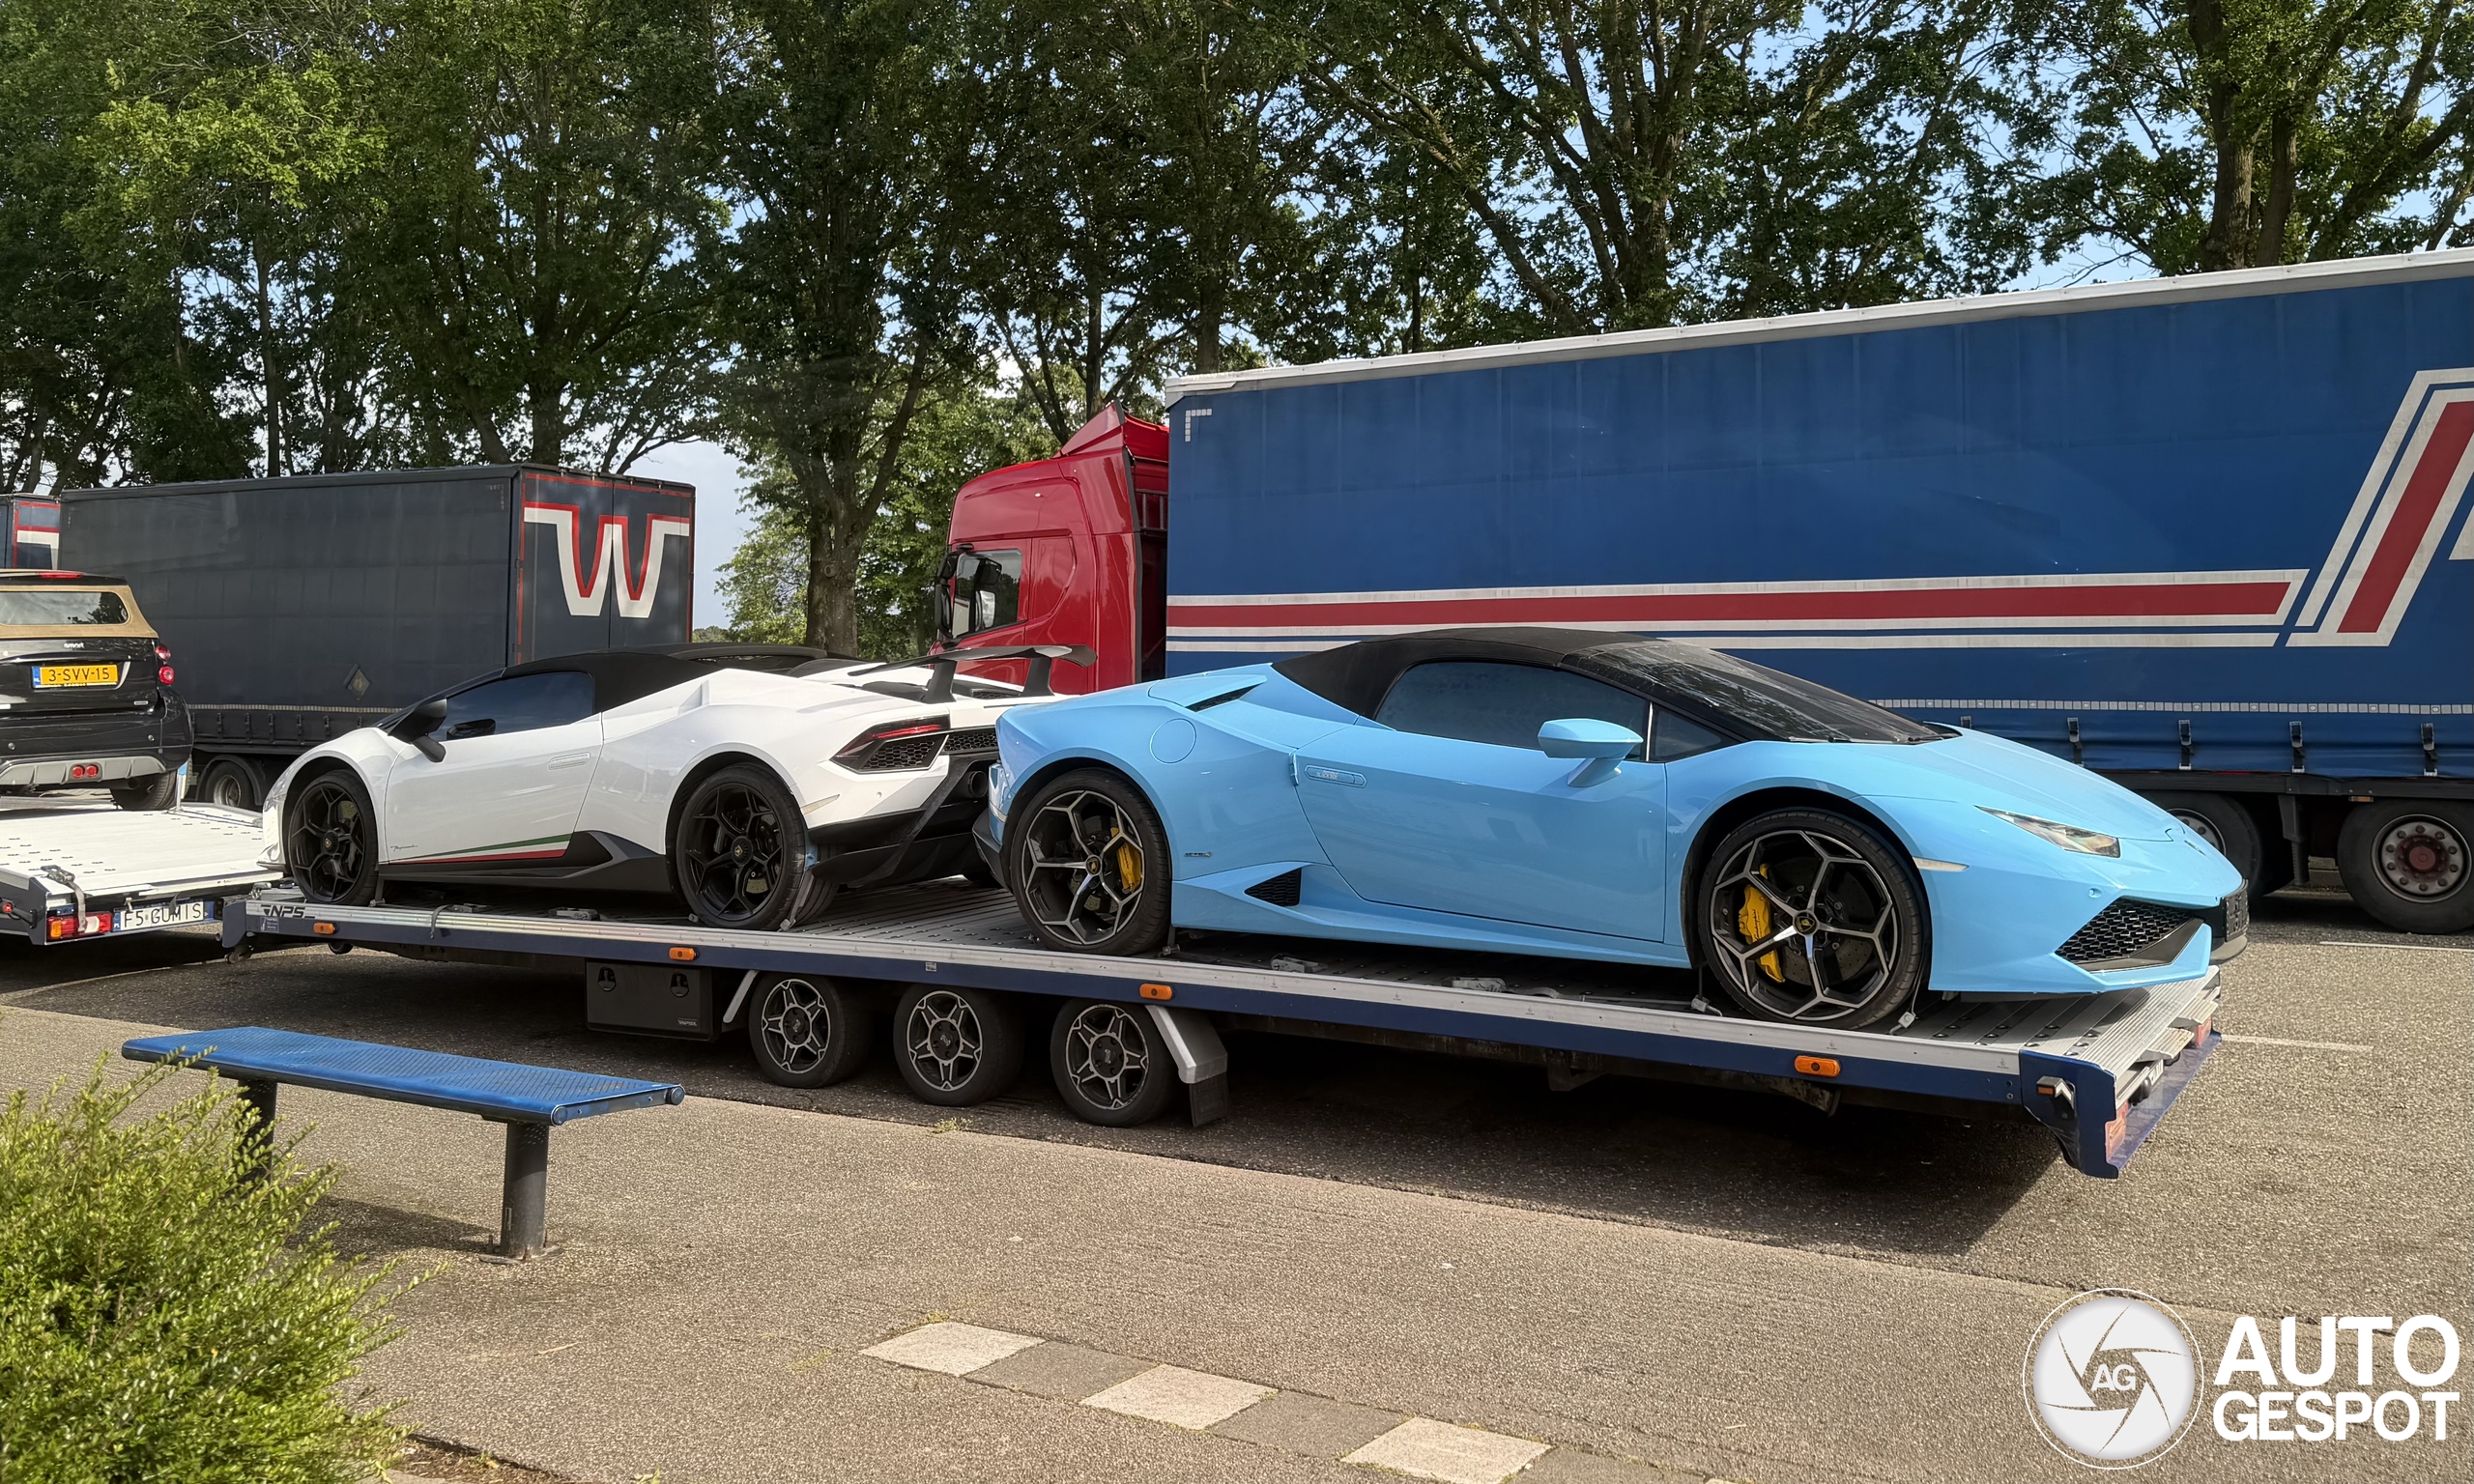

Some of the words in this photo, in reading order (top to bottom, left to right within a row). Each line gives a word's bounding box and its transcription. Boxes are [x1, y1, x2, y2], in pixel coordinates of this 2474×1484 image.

[48, 668, 110, 682] 3-SVV-15
[124, 910, 144, 928] F5
[151, 903, 201, 924] GUMIS
